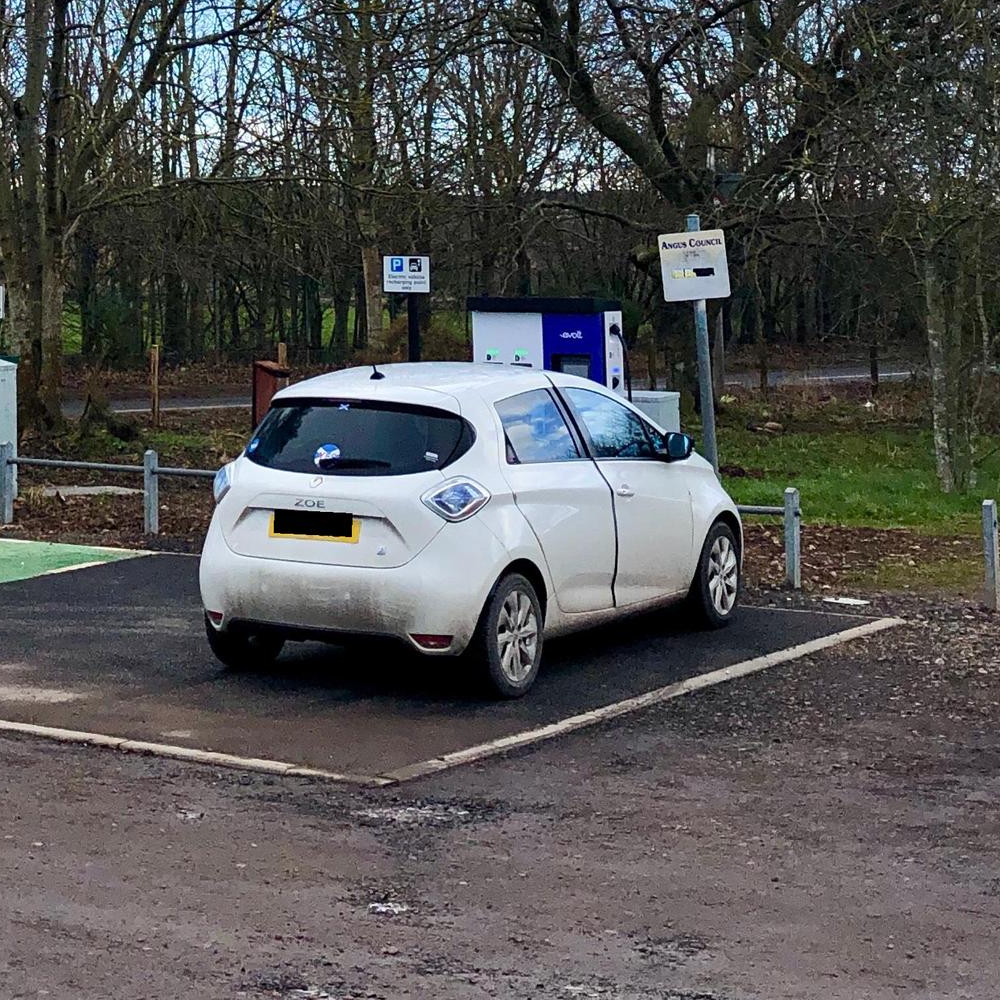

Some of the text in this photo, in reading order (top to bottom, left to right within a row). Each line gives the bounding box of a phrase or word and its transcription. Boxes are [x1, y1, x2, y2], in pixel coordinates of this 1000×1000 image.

[661, 238, 722, 250] ANGUS COUNCIL
[295, 498, 326, 508] ZOE
